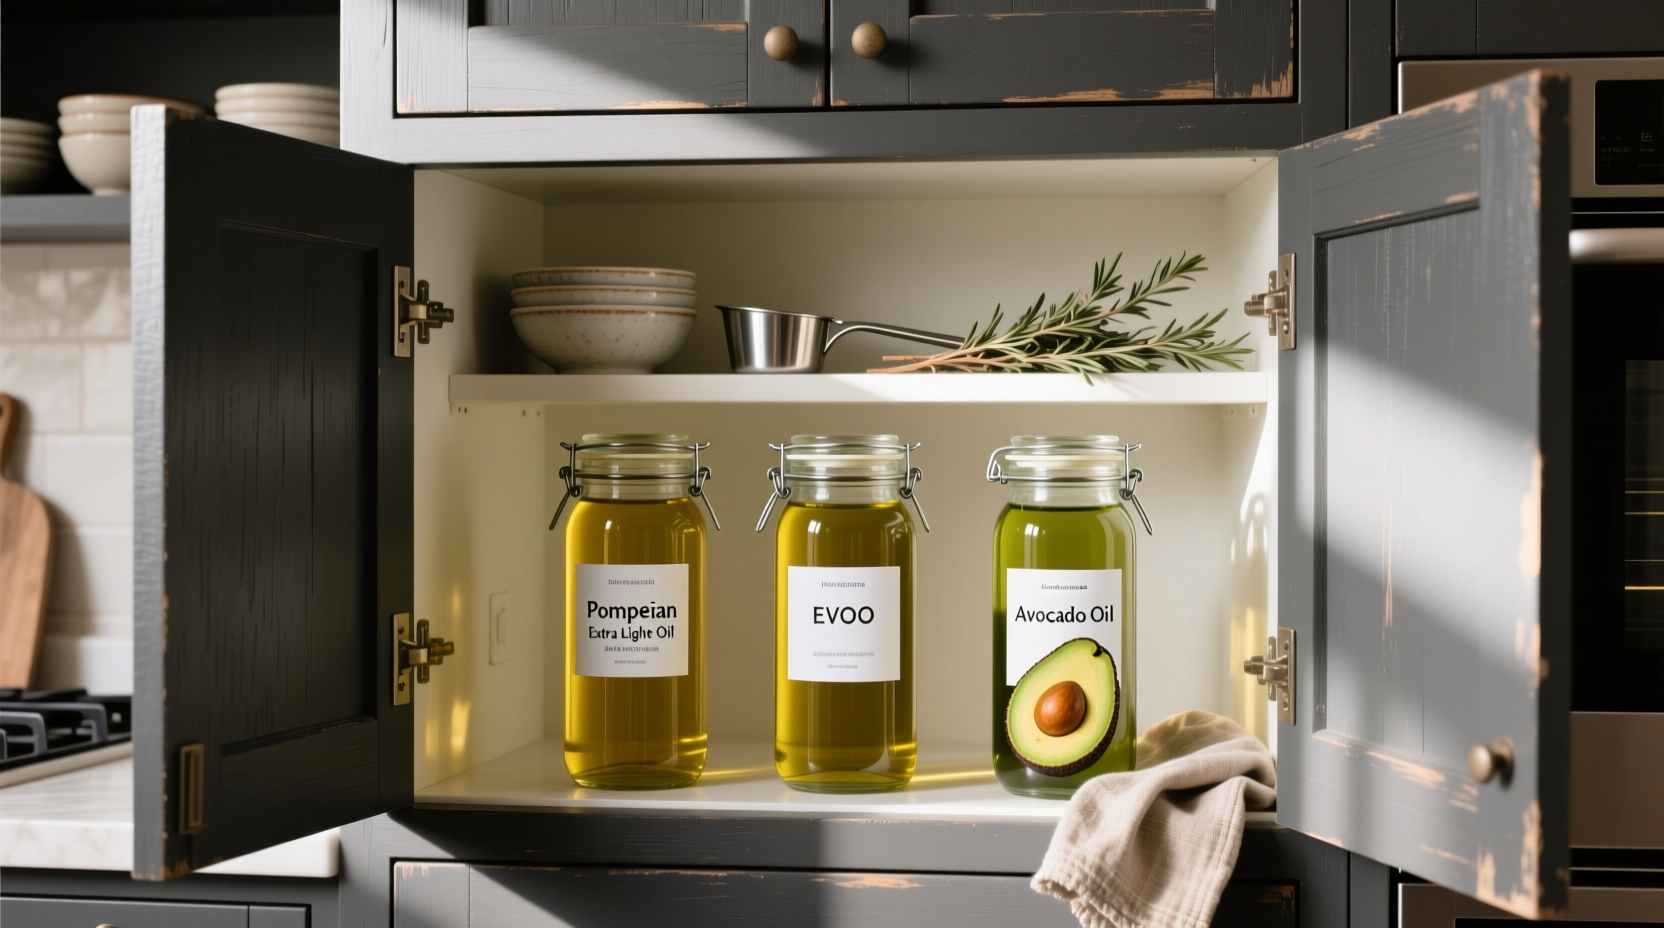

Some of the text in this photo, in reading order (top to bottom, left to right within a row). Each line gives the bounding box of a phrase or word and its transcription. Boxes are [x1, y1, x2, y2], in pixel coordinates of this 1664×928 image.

[813, 606, 875, 624] EVOO
[1015, 604, 1114, 623] Avocado Oil
[588, 624, 675, 642] Extra Light Oil
